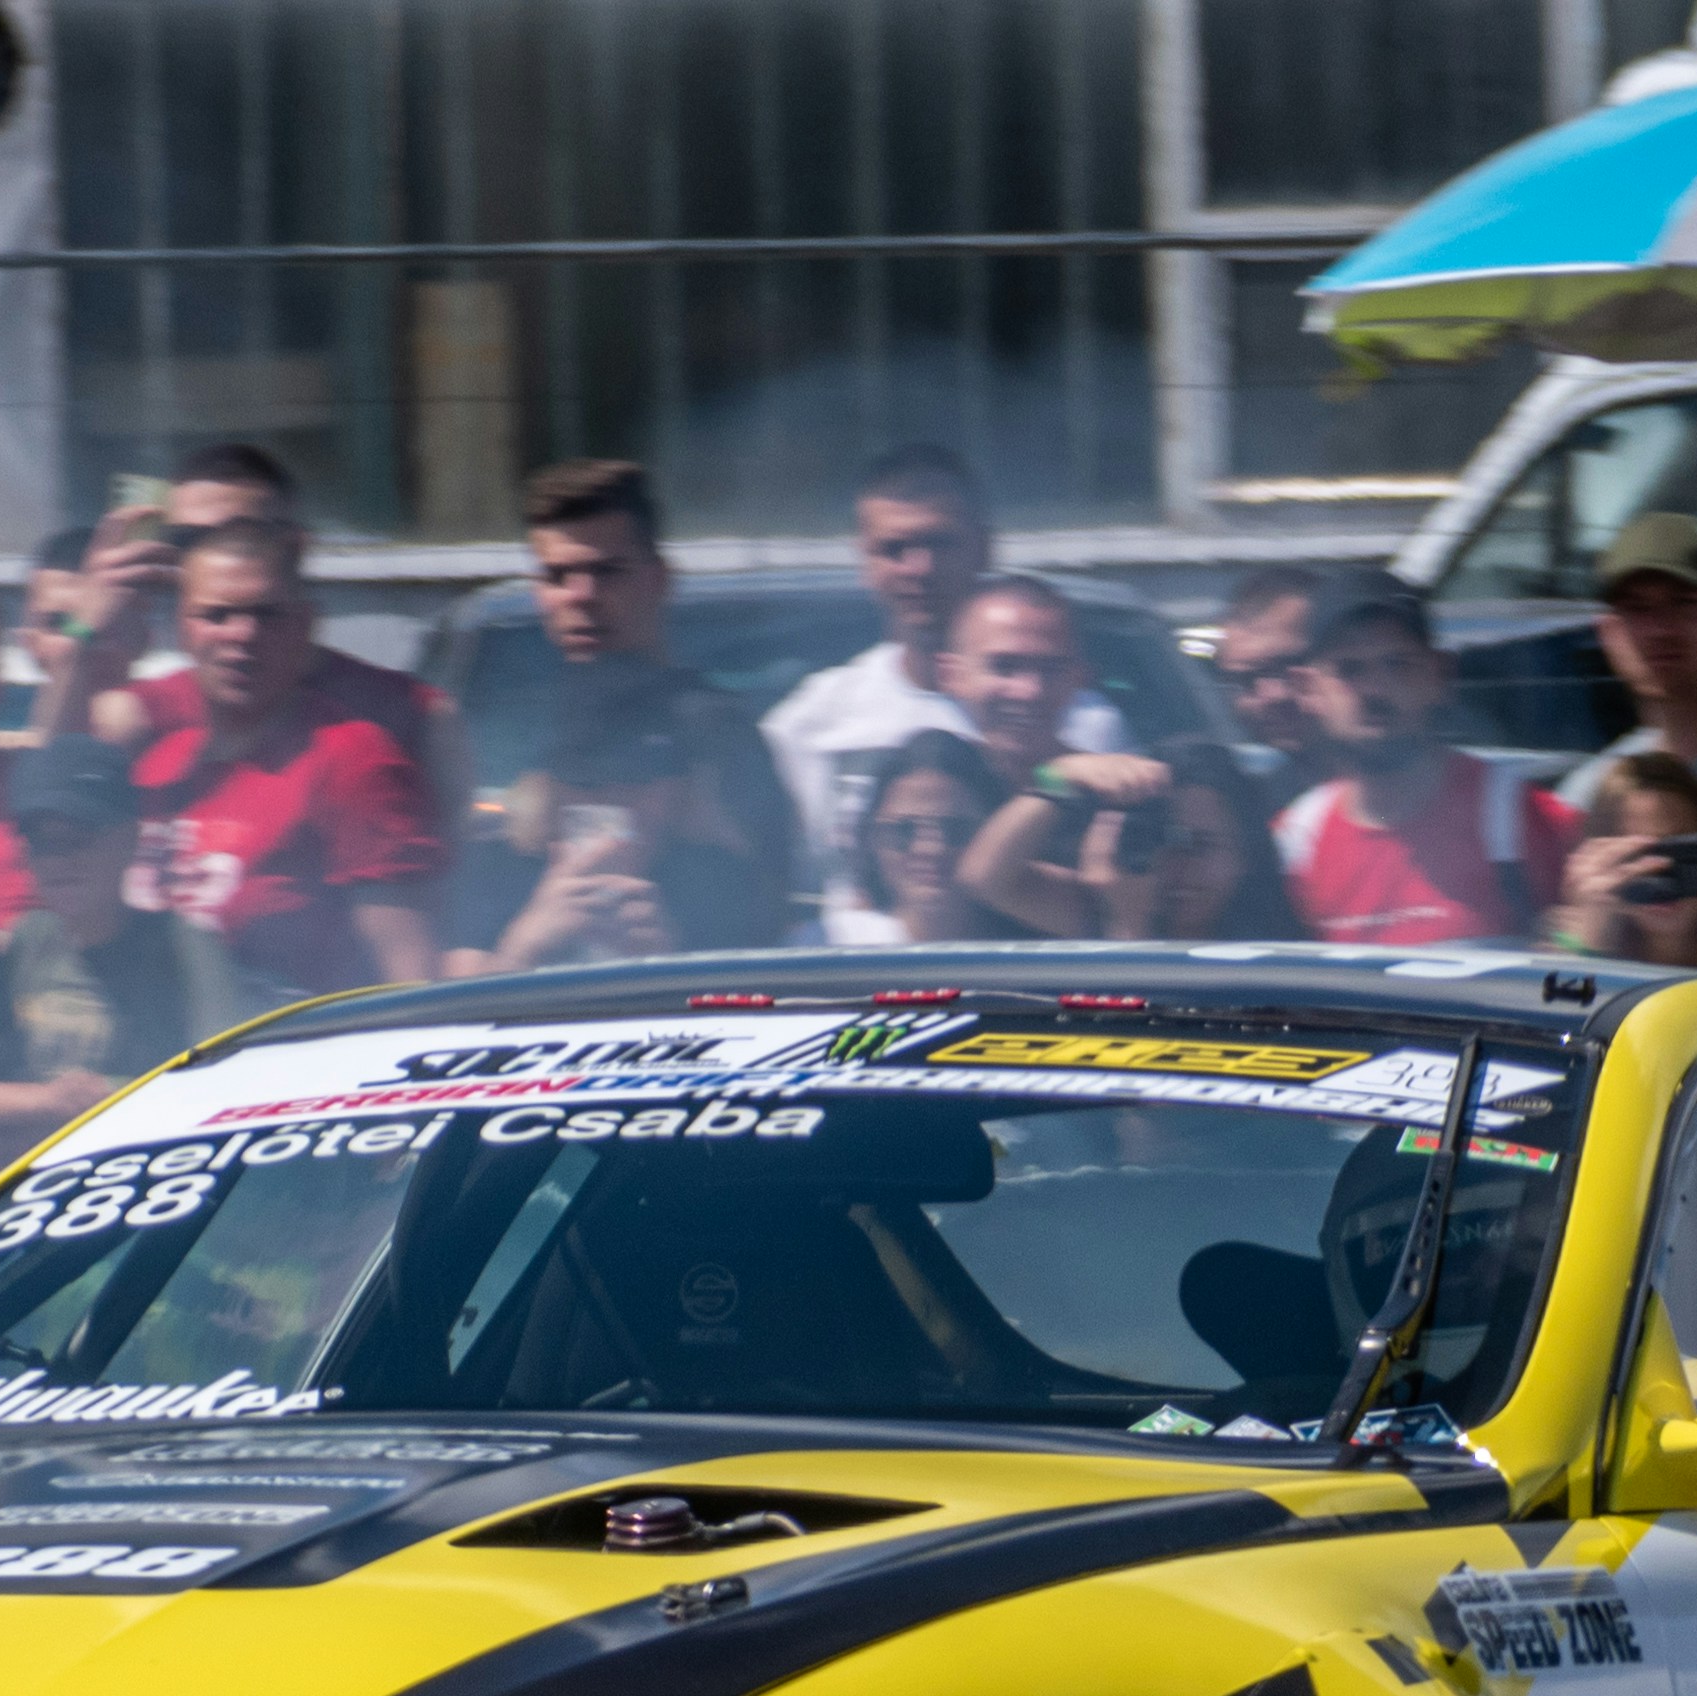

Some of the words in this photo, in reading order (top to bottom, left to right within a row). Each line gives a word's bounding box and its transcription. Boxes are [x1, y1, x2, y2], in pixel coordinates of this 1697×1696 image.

[12, 1113, 456, 1203] Cselőtei
[479, 1100, 825, 1144] Csaba
[1556, 1600, 1644, 1664] ZONE
